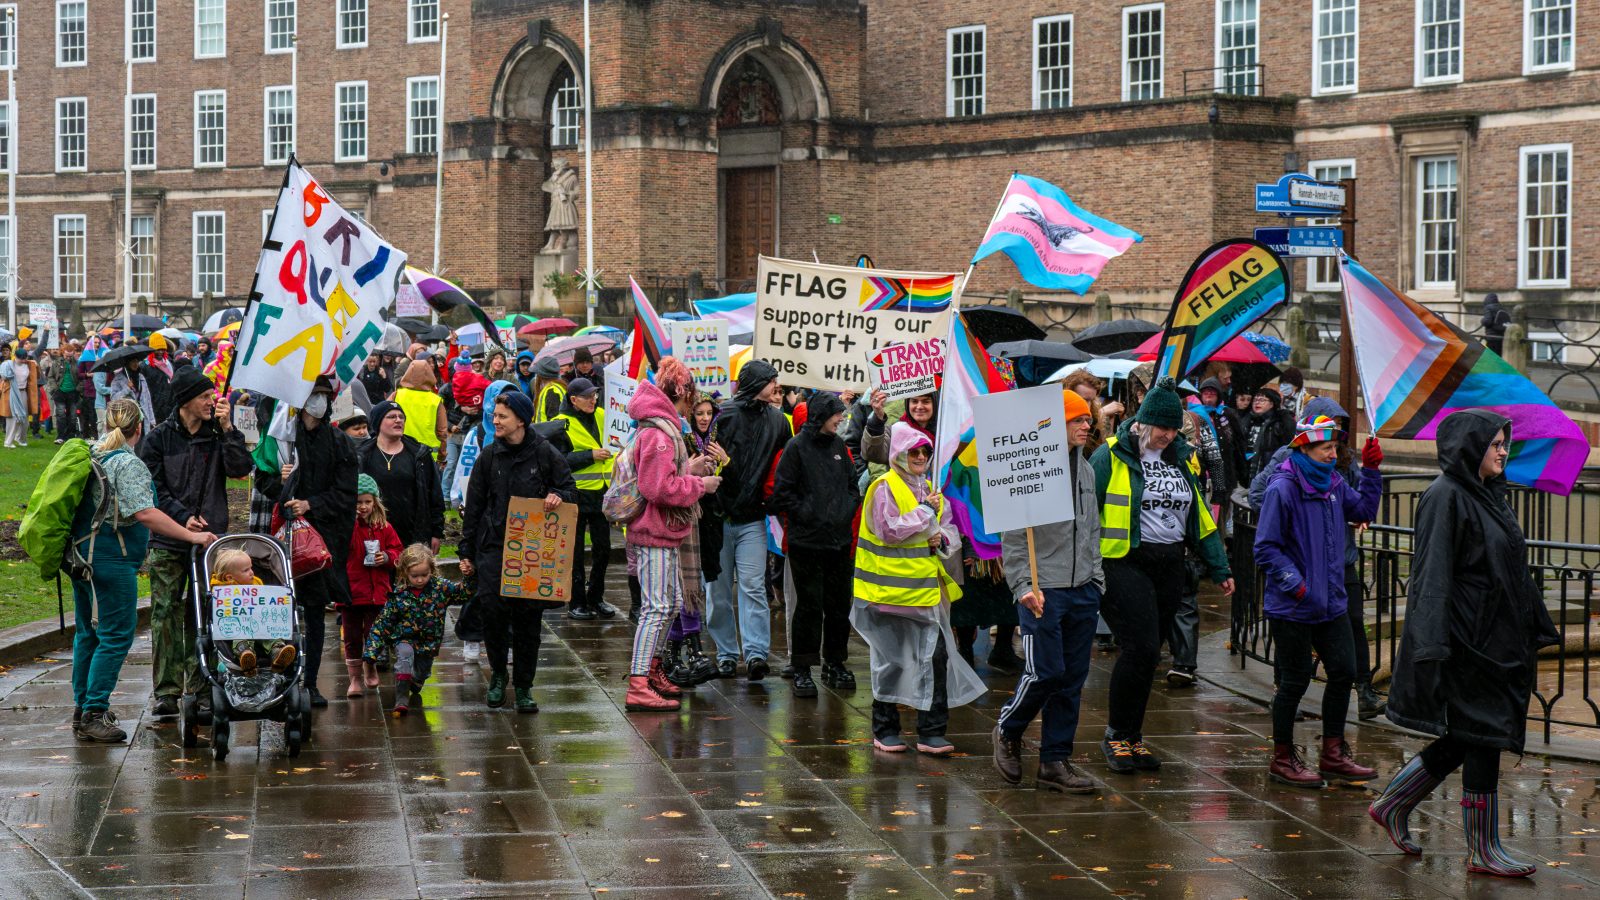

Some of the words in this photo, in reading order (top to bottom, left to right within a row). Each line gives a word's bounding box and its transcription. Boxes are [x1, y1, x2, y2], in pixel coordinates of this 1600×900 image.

[1009, 226, 1040, 249] AROUND
[765, 271, 847, 300] FFLAG
[1188, 257, 1264, 319] FFLAG
[1220, 291, 1264, 327] Bristol
[763, 307, 878, 334] supporting
[894, 317, 932, 333] our
[484, 329, 513, 343] FCK
[683, 326, 718, 344] YOU
[769, 327, 856, 353] LGBT+
[683, 345, 718, 362] ARE
[881, 337, 941, 365] TRANS
[760, 357, 808, 375] nes
[824, 363, 865, 383] with
[878, 384, 889, 392] All
[904, 377, 934, 387] struggles
[611, 418, 631, 433] ALLY
[992, 431, 1039, 447] FFLAG
[987, 447, 1040, 462] supporting
[1042, 443, 1060, 453] our
[1010, 458, 1046, 471] LGBT+
[987, 475, 1014, 487] loved
[1017, 472, 1041, 482] ones
[1043, 467, 1064, 478] with
[1143, 470, 1182, 478] EOPLE
[1009, 483, 1044, 497] PRIDE!
[1141, 499, 1190, 511] SPORT
[502, 511, 529, 596] DECOLONISE
[523, 528, 542, 574] YOUR
[538, 512, 560, 597] QUEERNESS
[214, 588, 258, 597] TRANS
[216, 597, 266, 608] PEOPLE
[269, 595, 291, 605] ARE
[216, 607, 255, 617] GREAT
